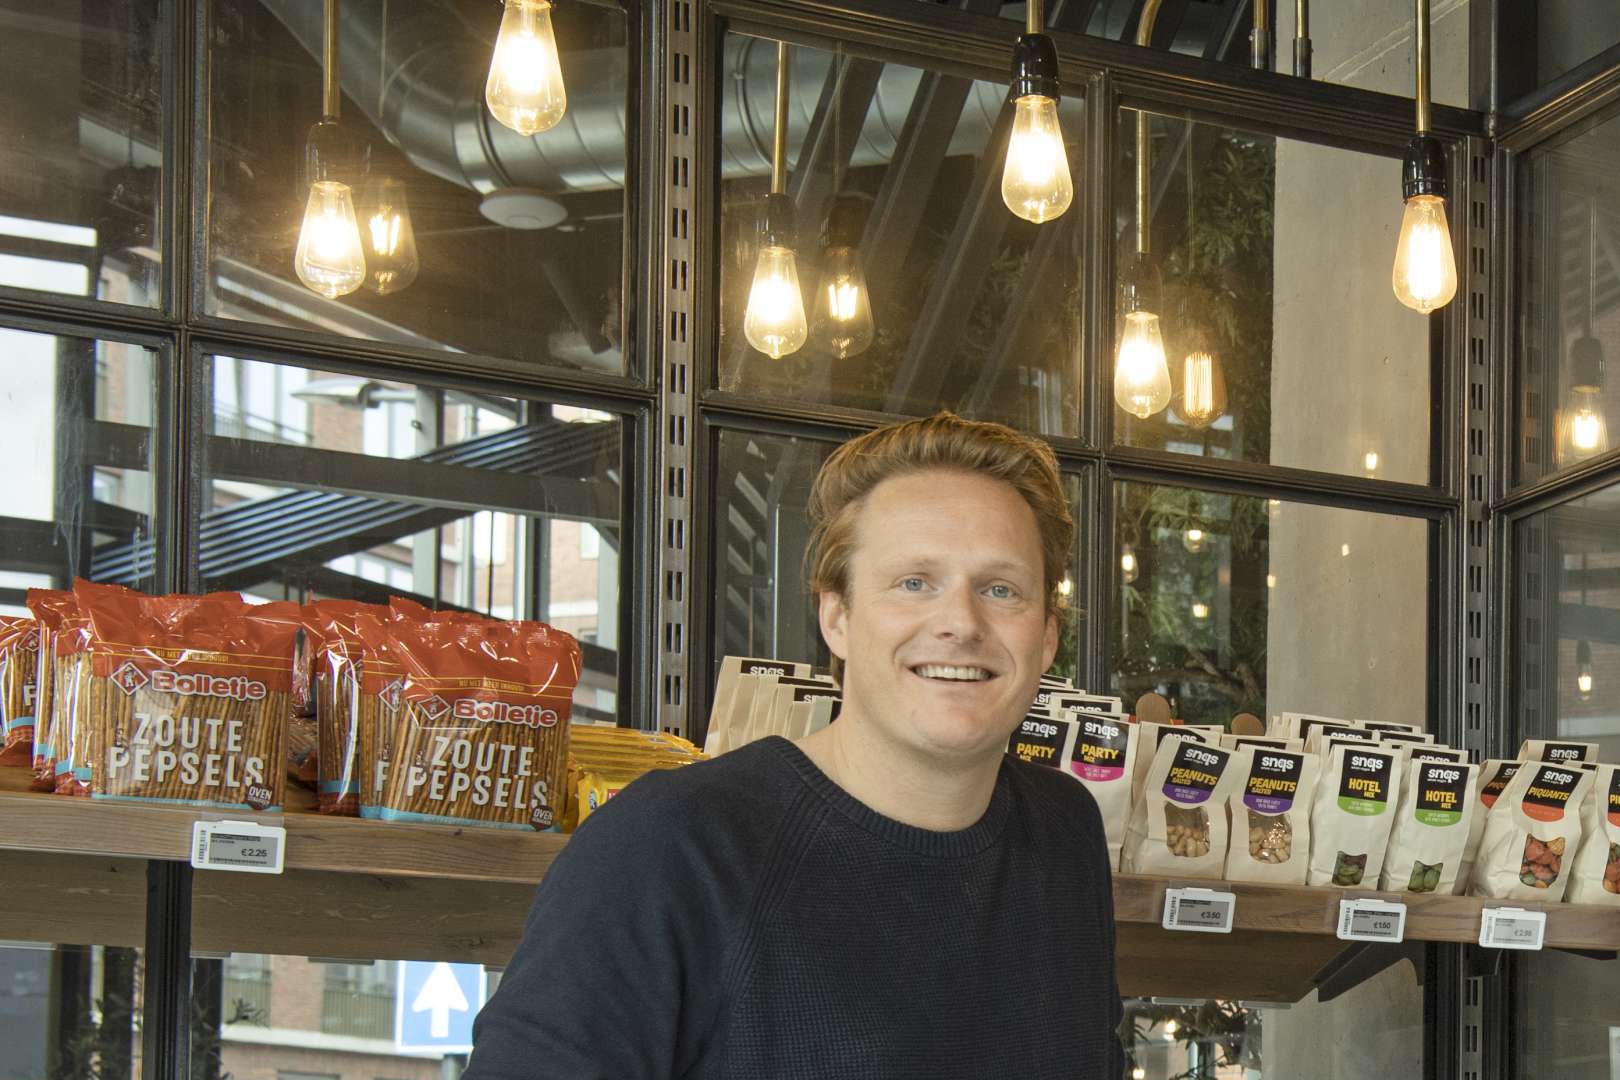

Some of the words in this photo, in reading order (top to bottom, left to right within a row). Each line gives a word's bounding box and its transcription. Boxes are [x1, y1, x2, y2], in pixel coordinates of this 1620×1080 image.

[152, 670, 266, 701] Bolletje
[453, 698, 558, 728] Bolletje
[133, 713, 243, 752] ZOUTE
[1022, 720, 1058, 738] snqs
[1085, 721, 1119, 740] snqs
[432, 735, 535, 776] ZOUTE
[1017, 743, 1055, 758] PARTY
[1081, 743, 1119, 759] PARTY
[1186, 748, 1219, 766] snqs
[1550, 748, 1579, 760] snqs
[108, 747, 264, 788] PEPSELS
[1262, 756, 1294, 772] snqs
[1351, 755, 1384, 772] snqs
[1170, 767, 1217, 785] PEANUTS
[1249, 777, 1296, 792] PEANUTS
[1427, 768, 1460, 784] snqs
[1544, 769, 1574, 785] snqs
[407, 767, 548, 809] PEPSELS
[1349, 778, 1381, 793] HOTEL
[1528, 787, 1570, 801] PIQUANTS
[1425, 790, 1457, 804] HOTEL
